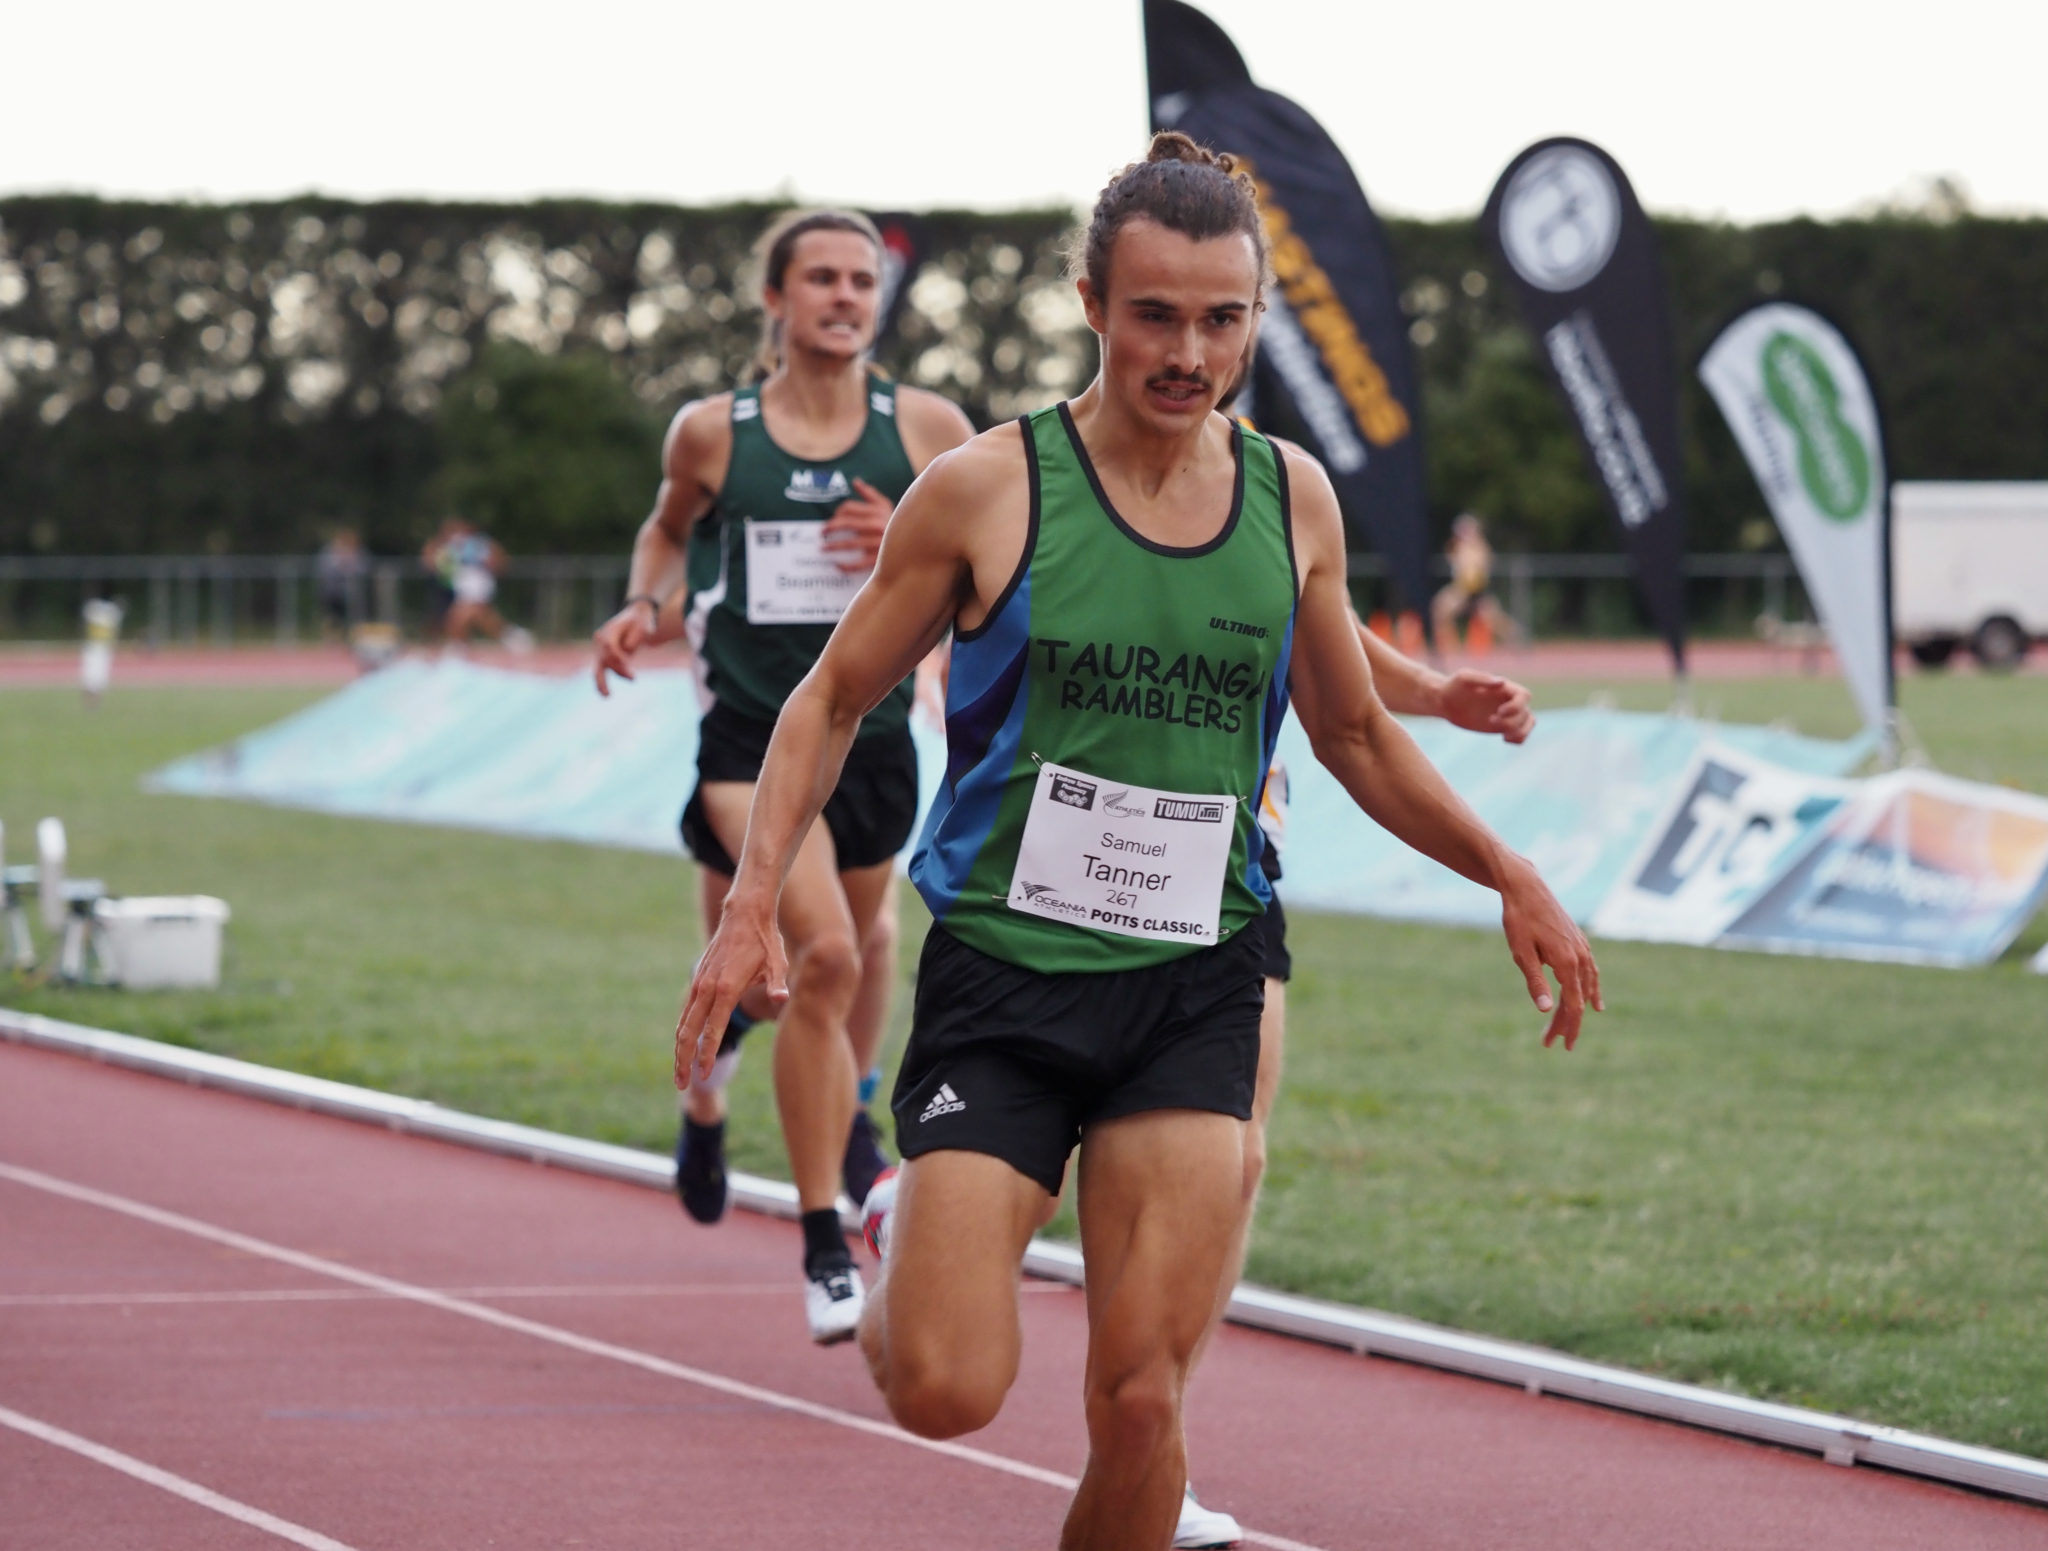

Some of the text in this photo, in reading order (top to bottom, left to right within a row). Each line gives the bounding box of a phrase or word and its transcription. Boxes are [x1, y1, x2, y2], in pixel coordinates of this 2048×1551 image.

[1060, 679, 1242, 734] RAMBLERS
[1157, 800, 1200, 820] TUMU
[1101, 832, 1167, 858] Samuel
[1083, 854, 1172, 892] Tanner
[1034, 894, 1087, 913] OCEANIA
[1106, 889, 1138, 909] 267
[1090, 908, 1204, 936] POTTS CLASSIC
[919, 1101, 966, 1123] adidas
